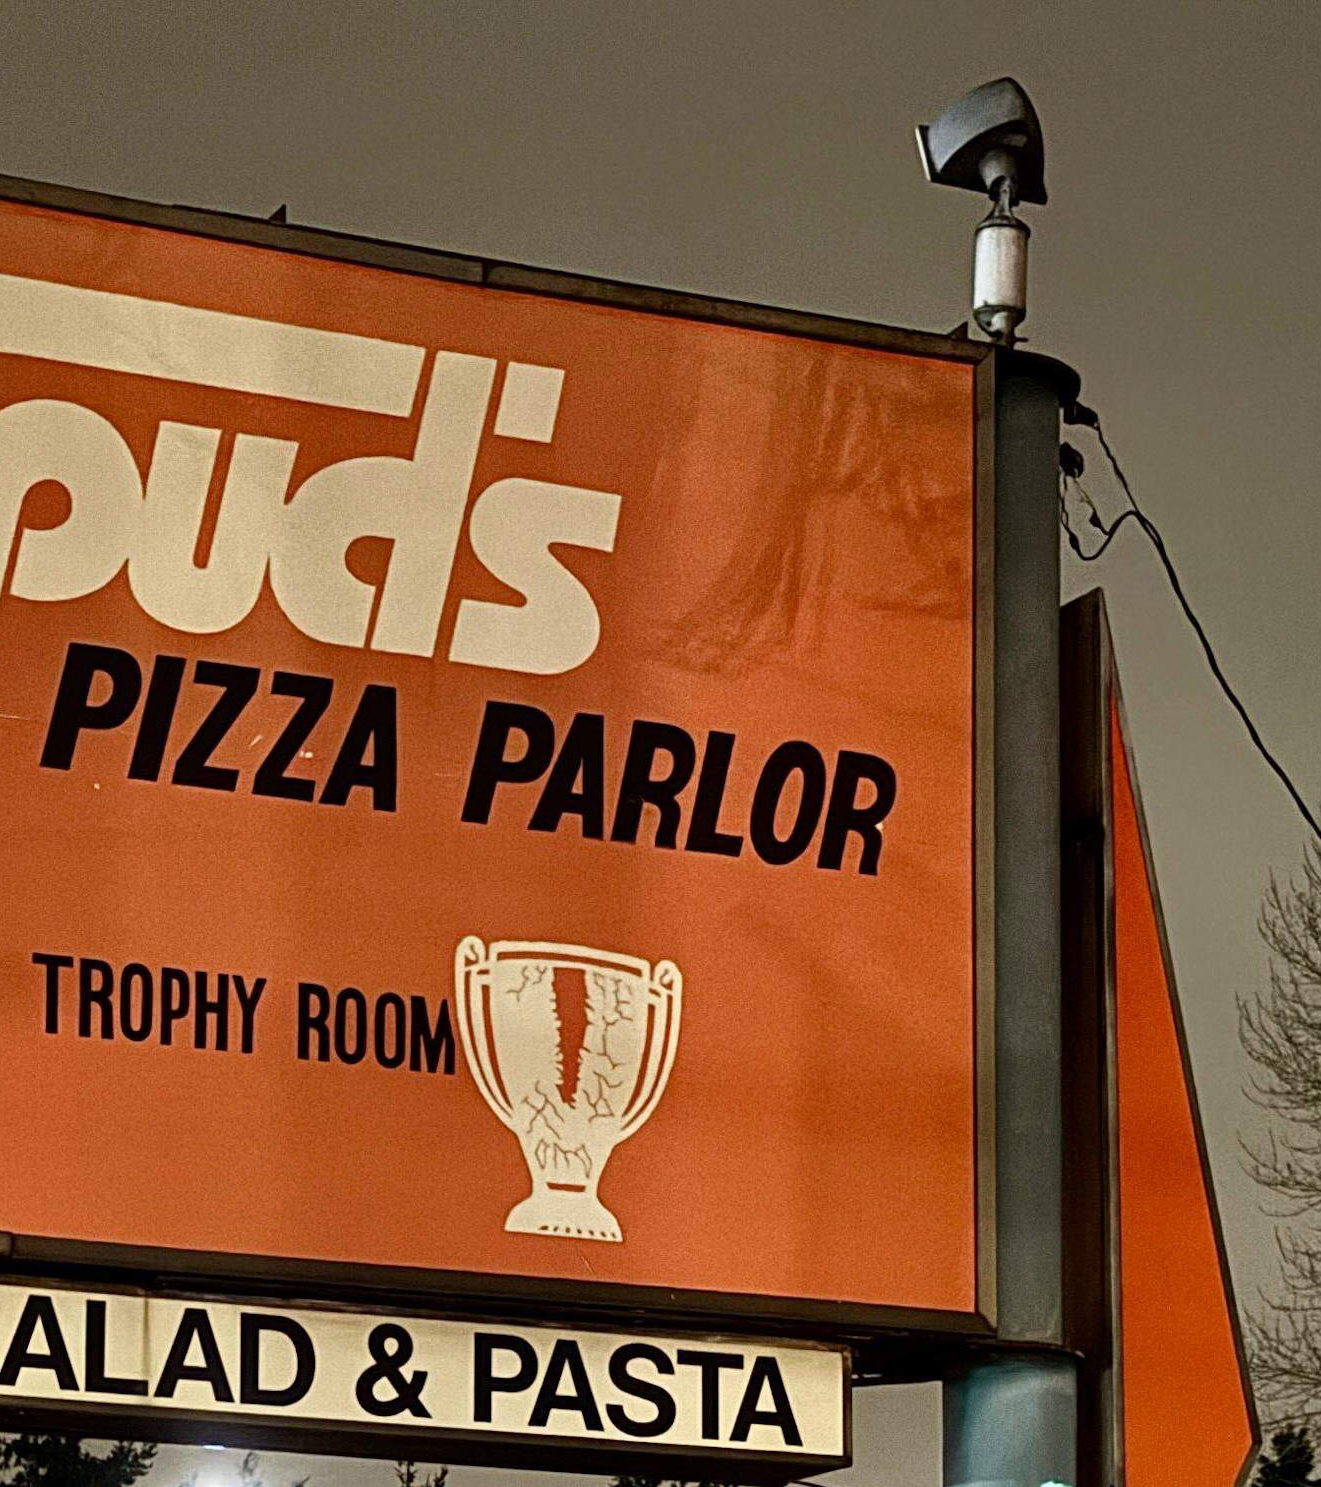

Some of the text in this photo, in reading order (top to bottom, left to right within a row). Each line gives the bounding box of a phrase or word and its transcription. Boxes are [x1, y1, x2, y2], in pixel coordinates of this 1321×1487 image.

[40, 642, 898, 876] PIZZA PARLOR
[32, 952, 457, 1076] TROPHY ROOM
[355, 1323, 432, 1419] &
[473, 1331, 803, 1448] PASTA
